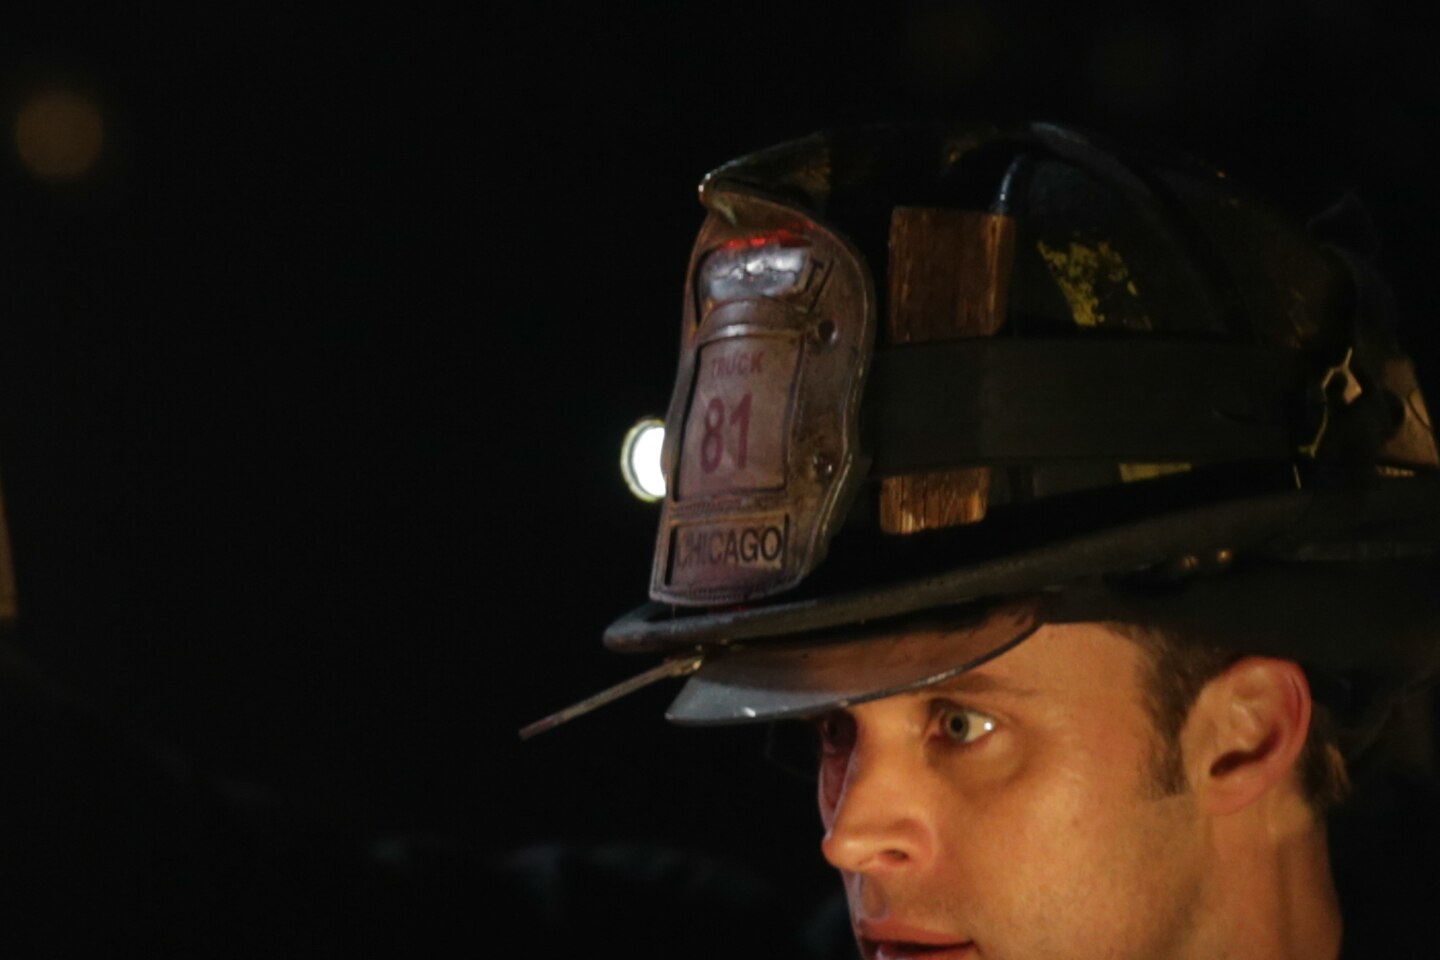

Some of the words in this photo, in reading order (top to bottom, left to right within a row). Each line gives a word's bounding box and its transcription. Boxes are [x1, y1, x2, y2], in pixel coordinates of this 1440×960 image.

[711, 351, 763, 377] TRUCK
[701, 394, 752, 474] 81
[676, 527, 782, 568] CHICAGO
